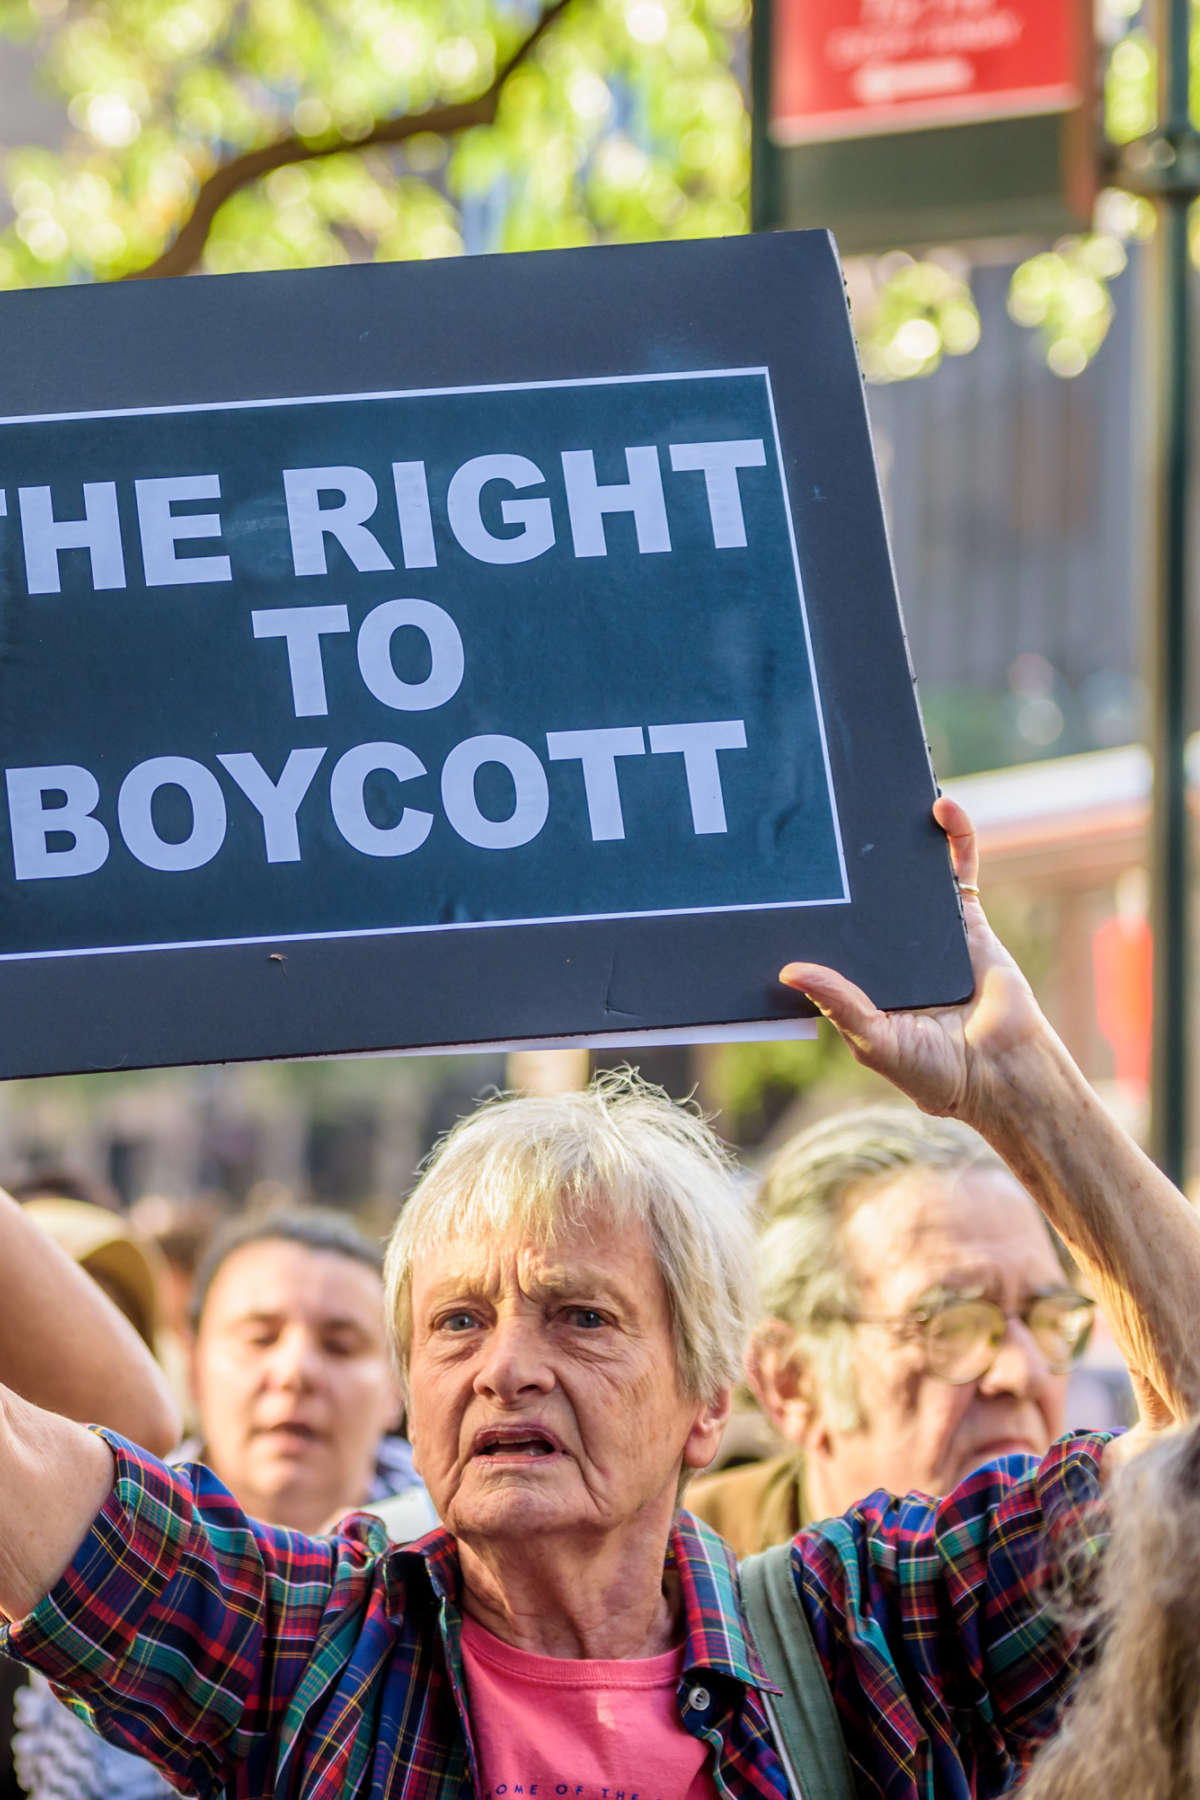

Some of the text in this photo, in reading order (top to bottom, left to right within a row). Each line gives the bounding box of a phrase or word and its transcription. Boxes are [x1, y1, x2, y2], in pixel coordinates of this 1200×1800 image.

[282, 438, 768, 576] RIGHT
[251, 598, 465, 718] TO
[6, 719, 747, 881] BOYCOTT
[555, 1784, 584, 1796] OF
[601, 1787, 640, 1800] THE
